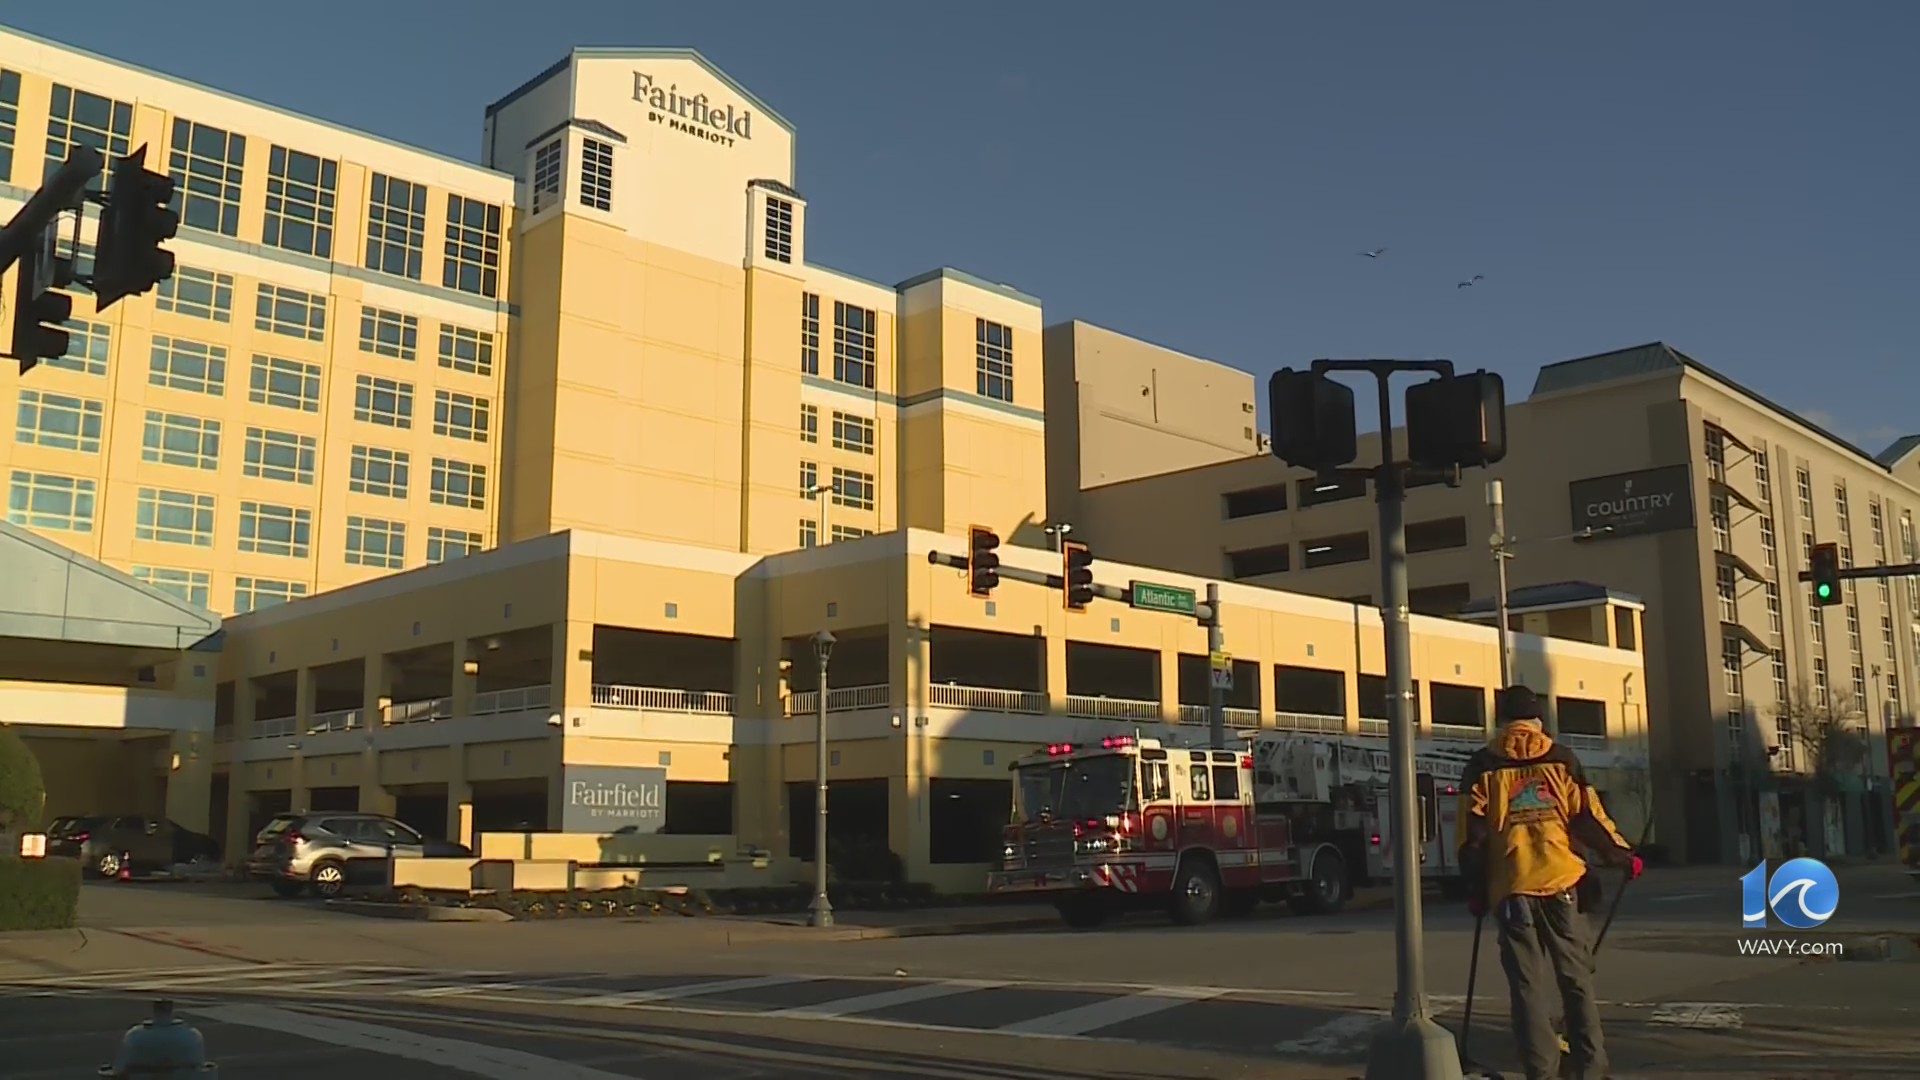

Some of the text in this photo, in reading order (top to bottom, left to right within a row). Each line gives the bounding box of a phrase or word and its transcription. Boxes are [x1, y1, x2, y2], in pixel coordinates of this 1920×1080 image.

[632, 70, 752, 140] Fairfield
[648, 111, 735, 148] BY MARRIOTT
[1141, 588, 1176, 606] Atlantic
[1193, 773, 1207, 792] 11
[571, 781, 659, 807] Fairfield
[591, 808, 660, 818] BY MARRIOTT
